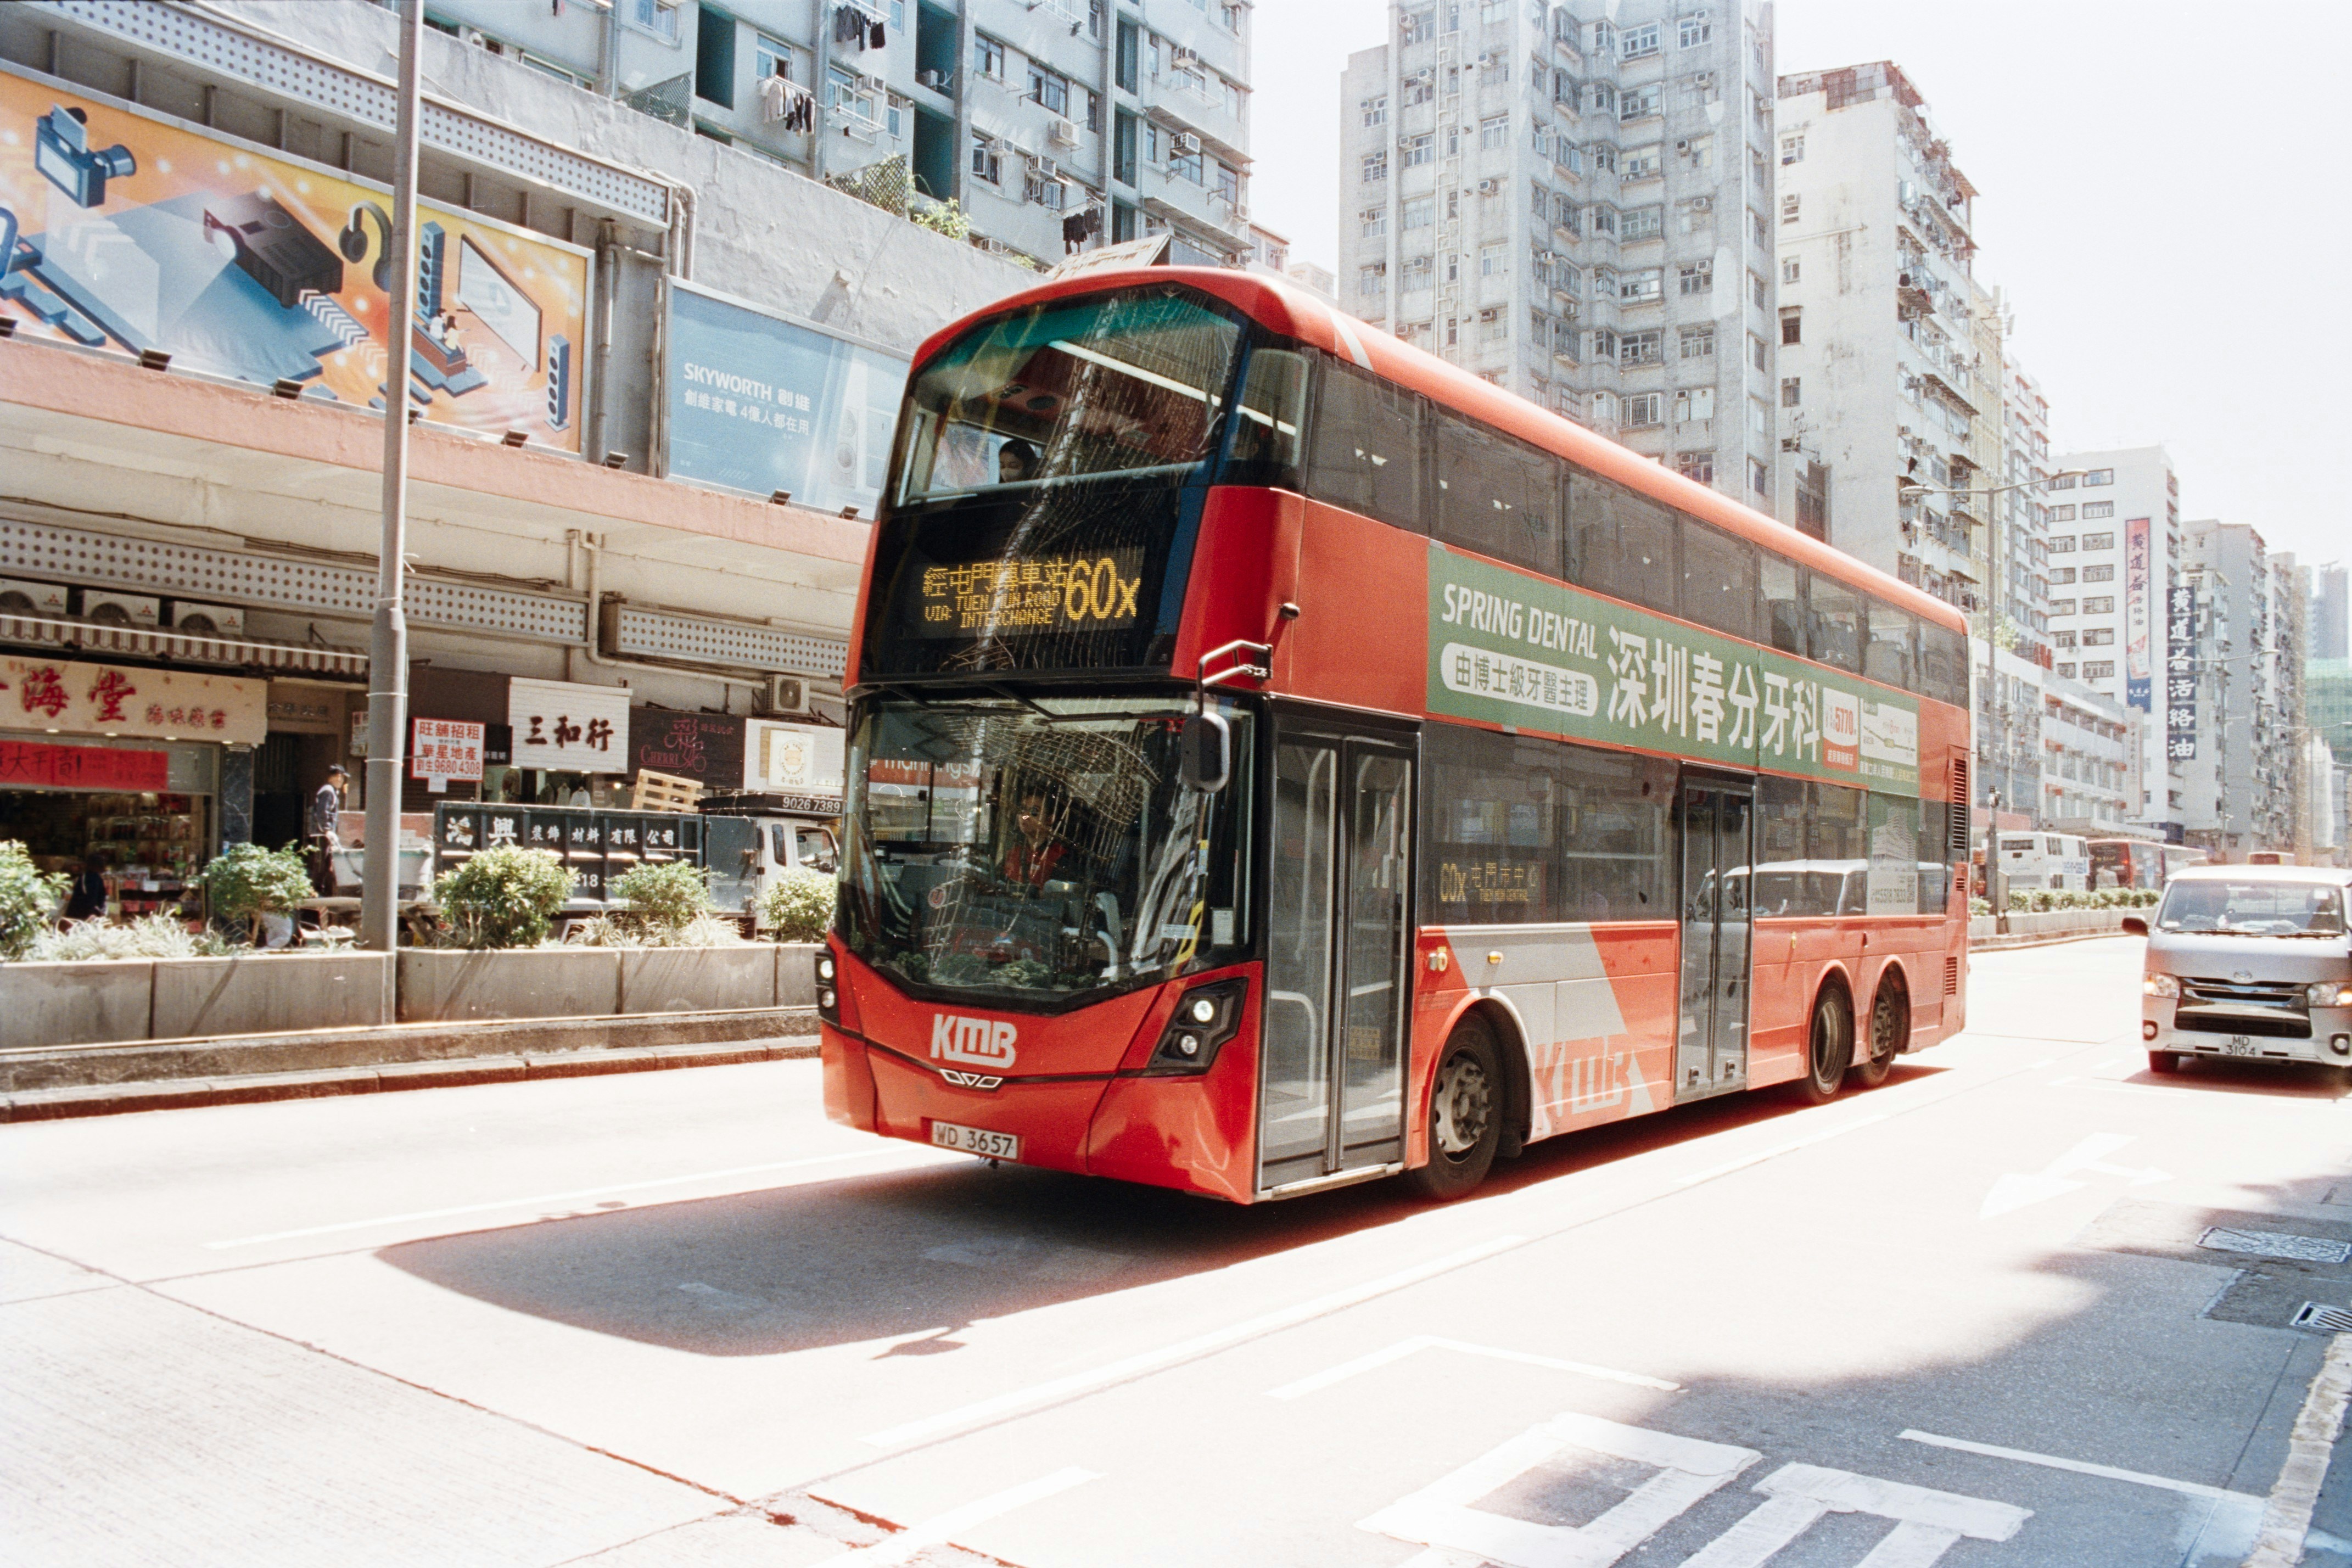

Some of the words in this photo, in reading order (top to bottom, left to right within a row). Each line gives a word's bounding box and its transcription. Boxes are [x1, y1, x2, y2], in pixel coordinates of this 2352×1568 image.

[684, 362, 772, 401] SKYWORTH
[955, 594, 989, 611] TUEN
[1025, 590, 1060, 607] ROAD
[960, 608, 1052, 628] INTERCHANGE
[1442, 583, 1522, 640] SPRING
[1527, 607, 1598, 659] DENTAL
[0, 667, 136, 722] 海堂
[1455, 651, 1588, 710] 由博士級牙醫主理
[1608, 624, 1820, 762] 深圳春分牙科
[419, 721, 480, 740] 旺舖招租
[525, 716, 614, 751] 三和行
[422, 744, 477, 760] 華星地產
[782, 796, 811, 810] 9026
[813, 799, 841, 813] 7389
[931, 1014, 1018, 1068] KMB
[2226, 1044, 2256, 1056] 3104
[2232, 1035, 2249, 1046] MD
[1535, 1034, 1633, 1131] KMB
[937, 1125, 958, 1146] WD
[967, 1130, 1013, 1155] 3657
